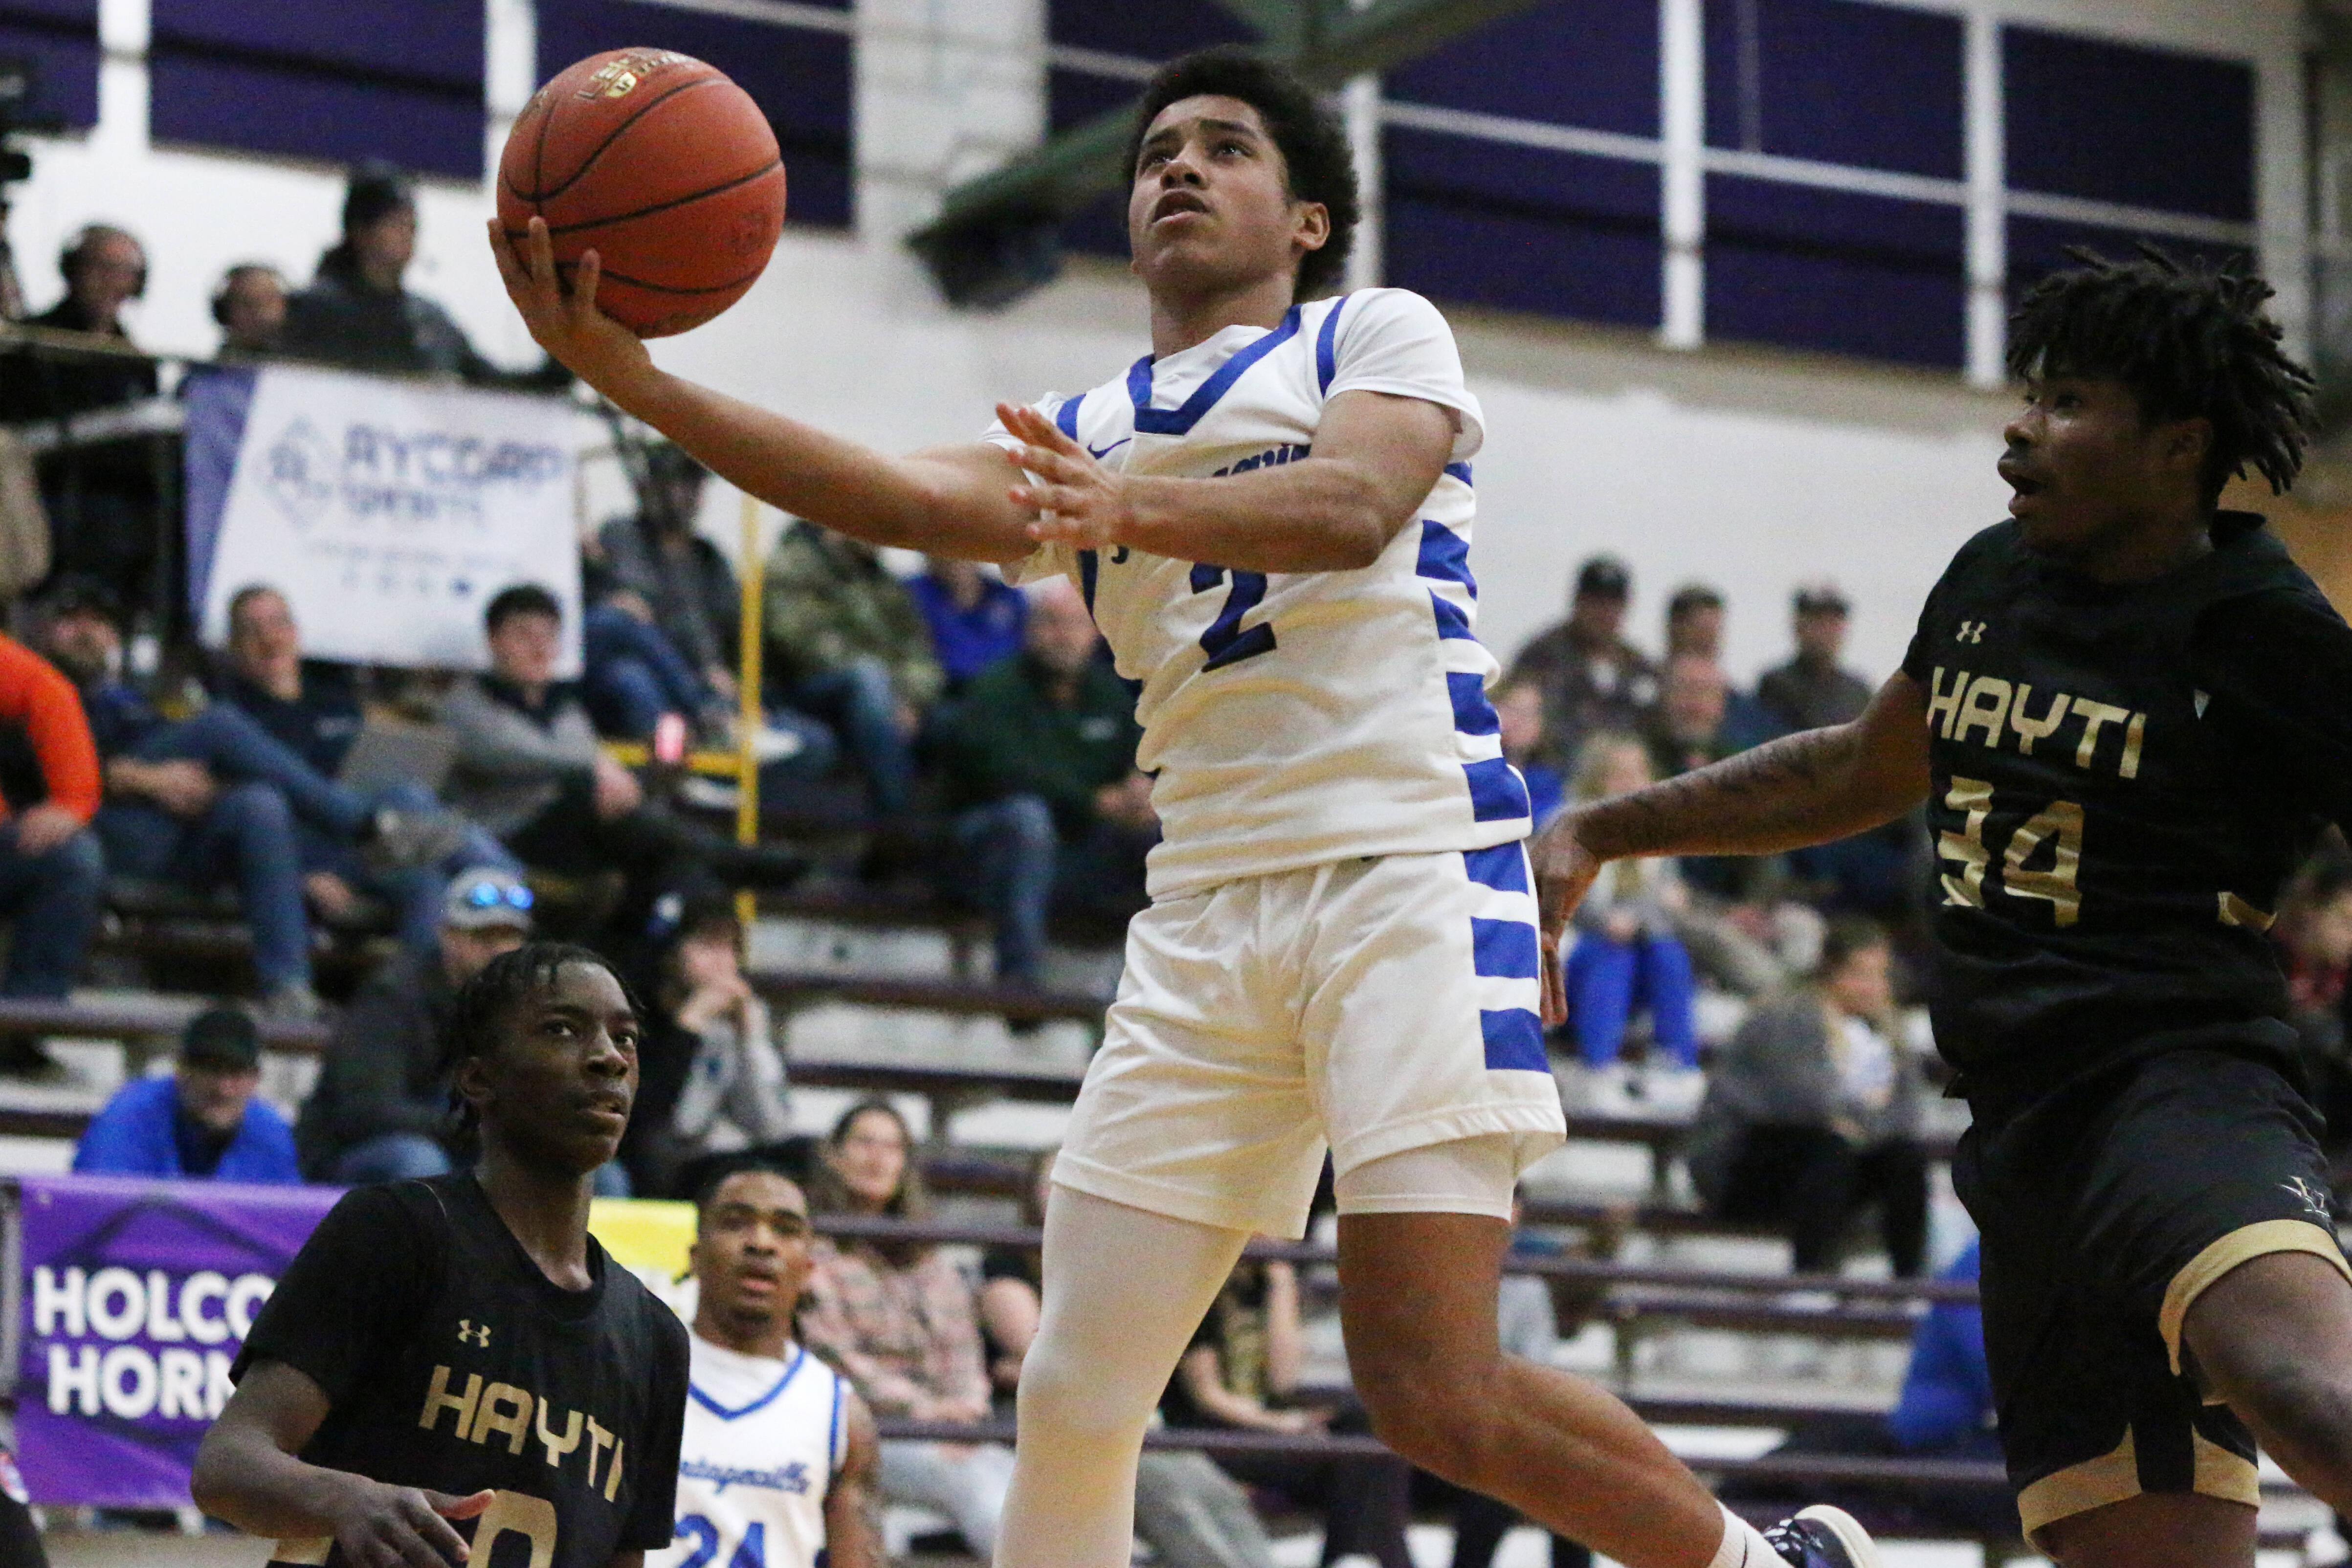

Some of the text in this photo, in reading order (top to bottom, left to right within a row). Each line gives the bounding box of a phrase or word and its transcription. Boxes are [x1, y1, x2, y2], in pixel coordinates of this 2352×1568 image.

[1189, 561, 1277, 673] 2
[1926, 666, 2147, 779] HAYTI
[1937, 774, 2085, 927] 34
[418, 1365, 624, 1502] HAYTI
